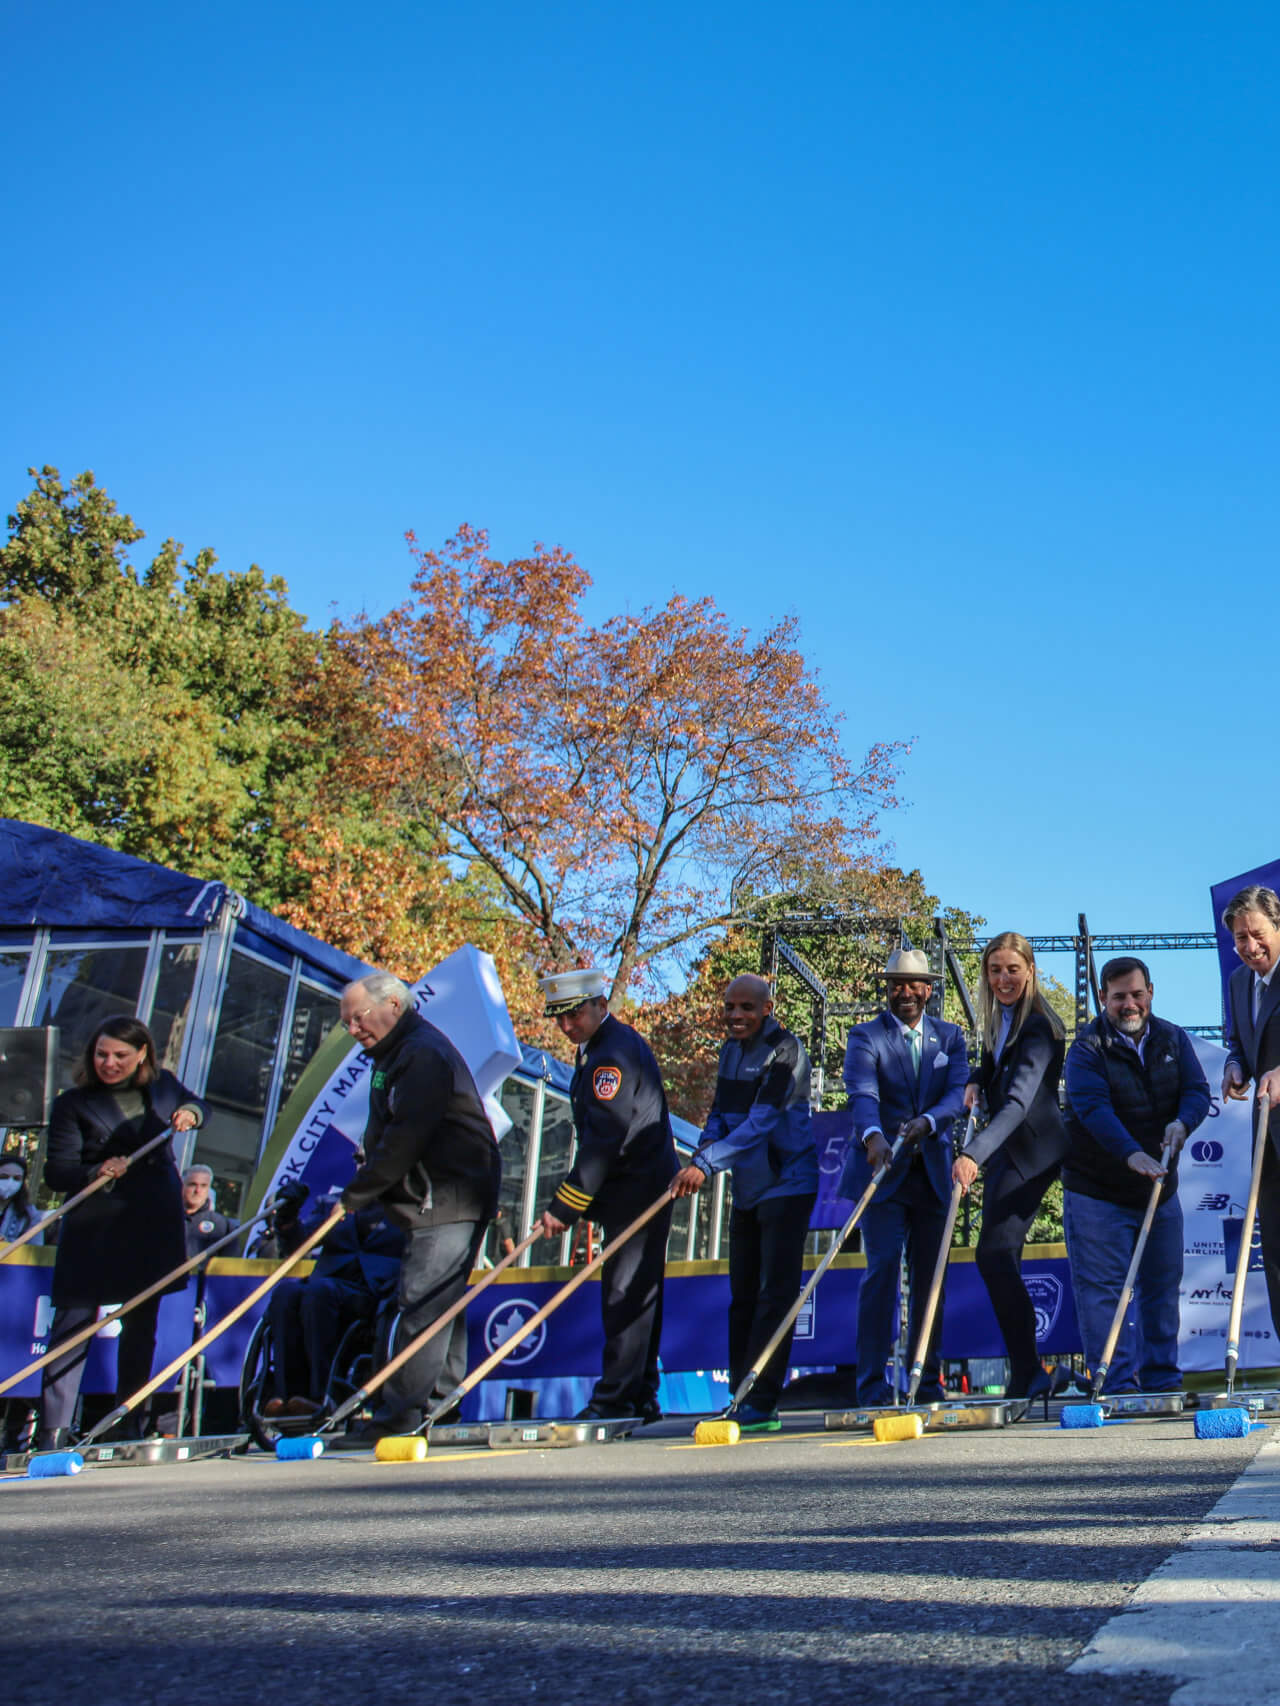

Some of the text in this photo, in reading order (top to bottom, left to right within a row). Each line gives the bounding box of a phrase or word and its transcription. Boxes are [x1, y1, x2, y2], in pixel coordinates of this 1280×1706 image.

[299, 1100, 336, 1153] CITY
[1193, 1241, 1225, 1249] UNITE
[1183, 1248, 1225, 1256] AIRLINE
